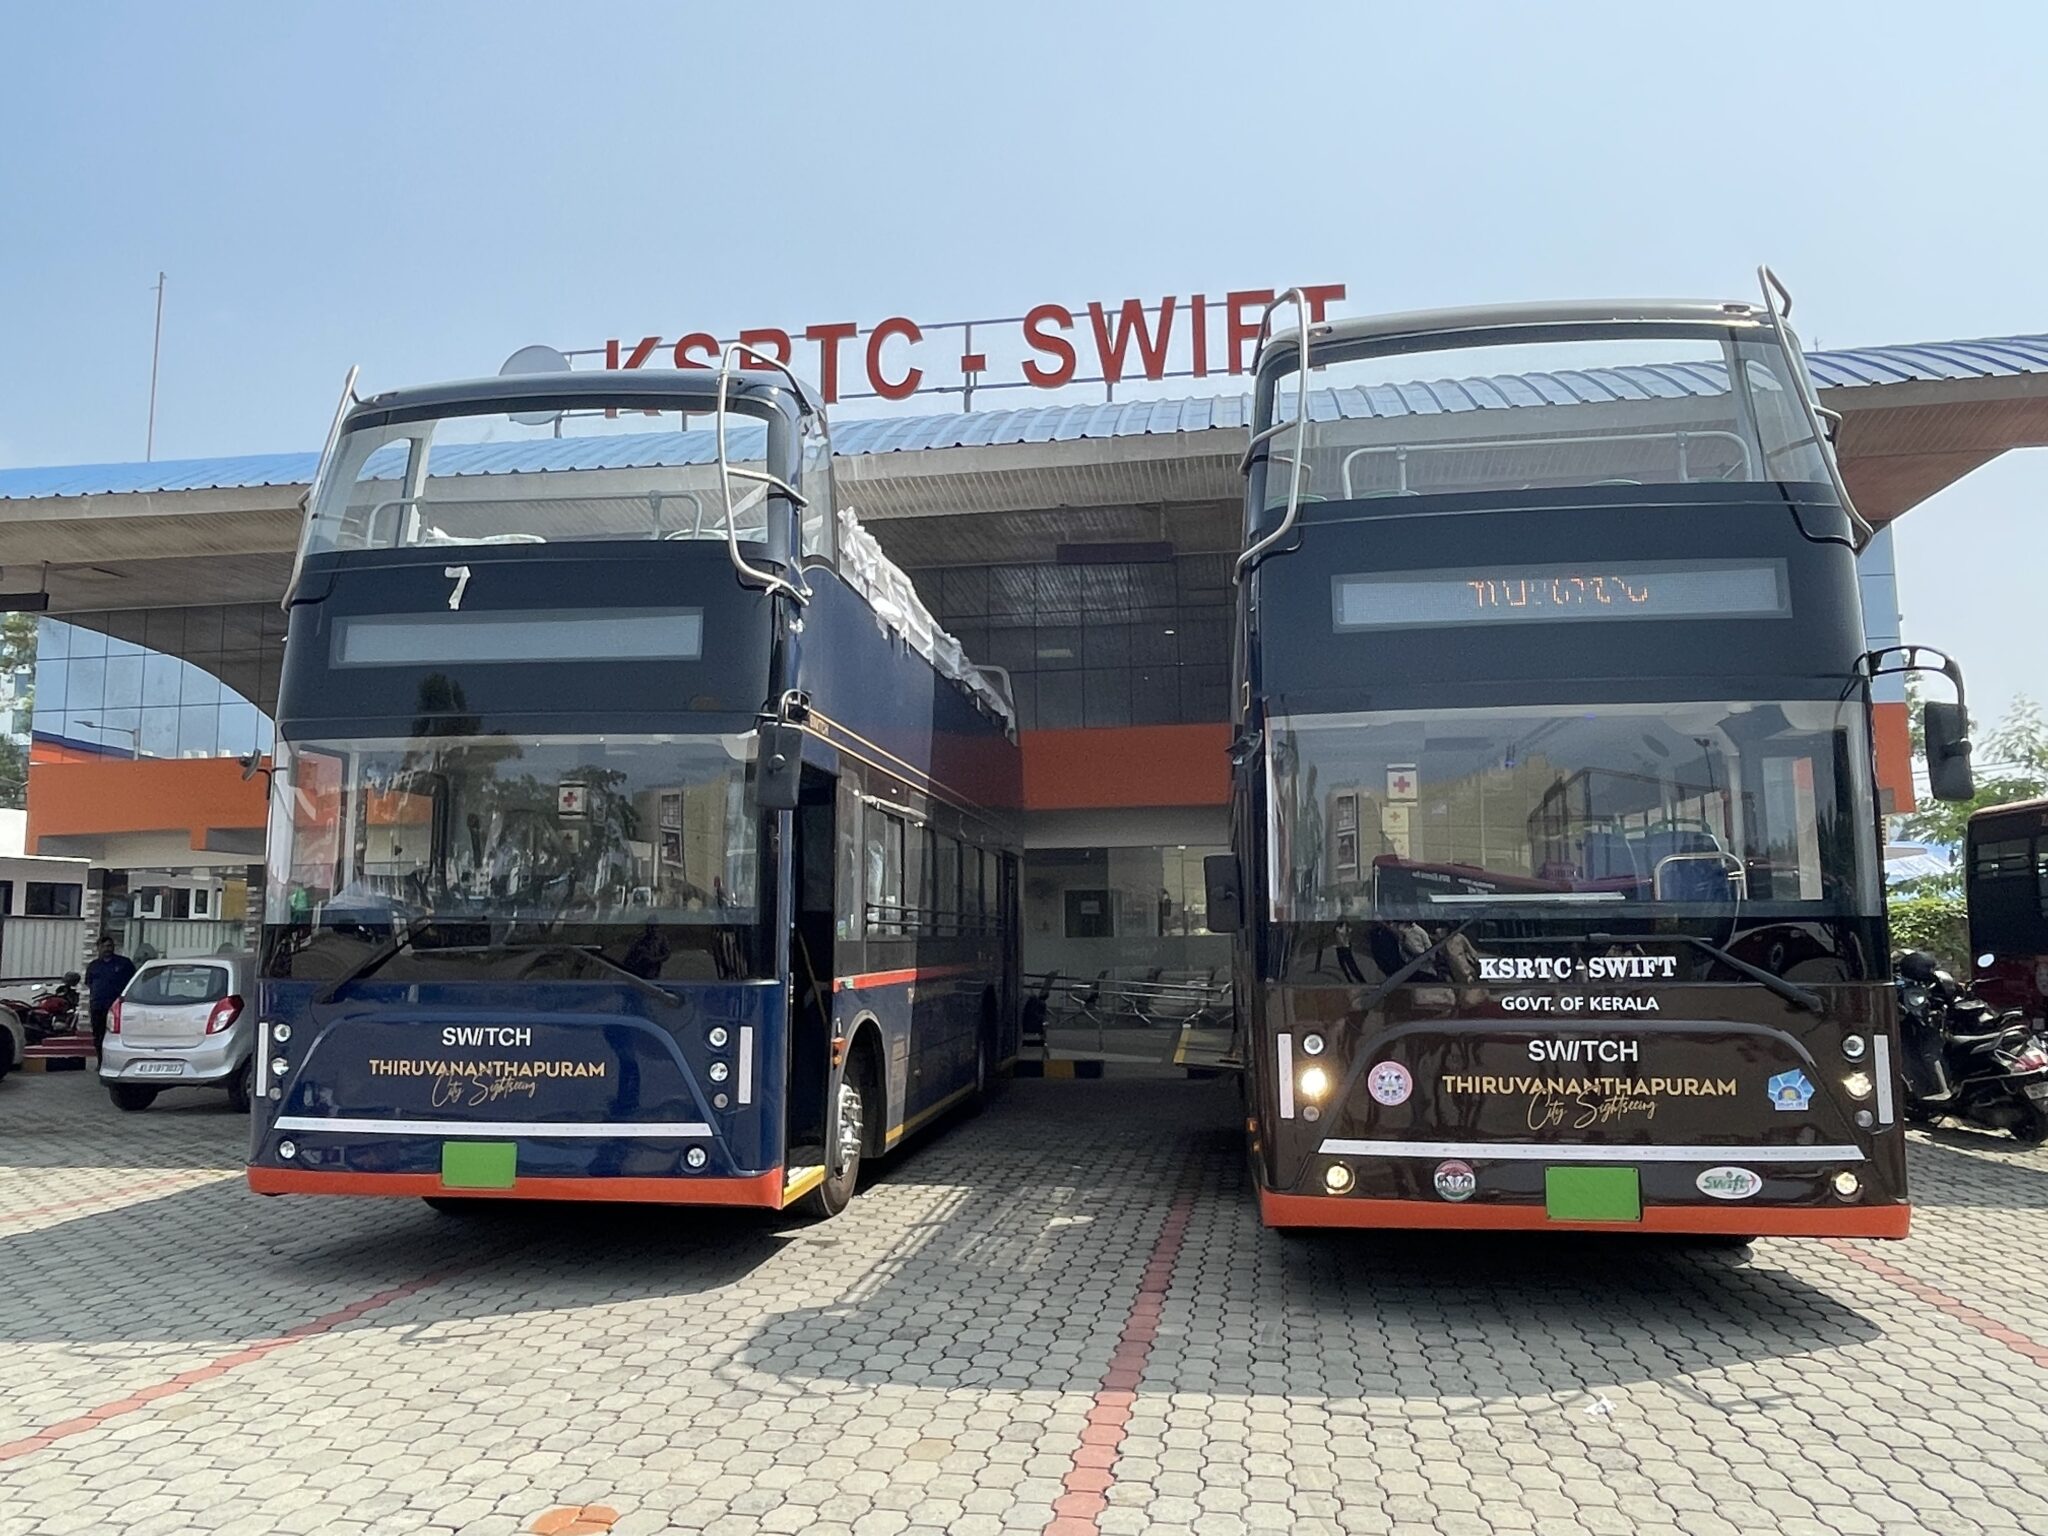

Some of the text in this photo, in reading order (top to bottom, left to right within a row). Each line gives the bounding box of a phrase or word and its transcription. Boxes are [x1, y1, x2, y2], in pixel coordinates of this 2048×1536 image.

[1021, 284, 1346, 389] SWIFT
[444, 565, 471, 610] 7
[1478, 957, 1572, 980] KSRTC
[1588, 955, 1677, 979] SWIFT
[1501, 995, 1660, 1012] GOVT. OF KERALA
[442, 1027, 532, 1047] SWITCH
[1528, 1040, 1639, 1063] SWITCH
[369, 1059, 606, 1078] THIRUVANANTHAPURAM
[1442, 1075, 1738, 1097] THIRUVANANTHAPURAM
[1527, 1085, 1658, 1131] City Sightseeing
[1702, 1170, 1748, 1192] Swift
